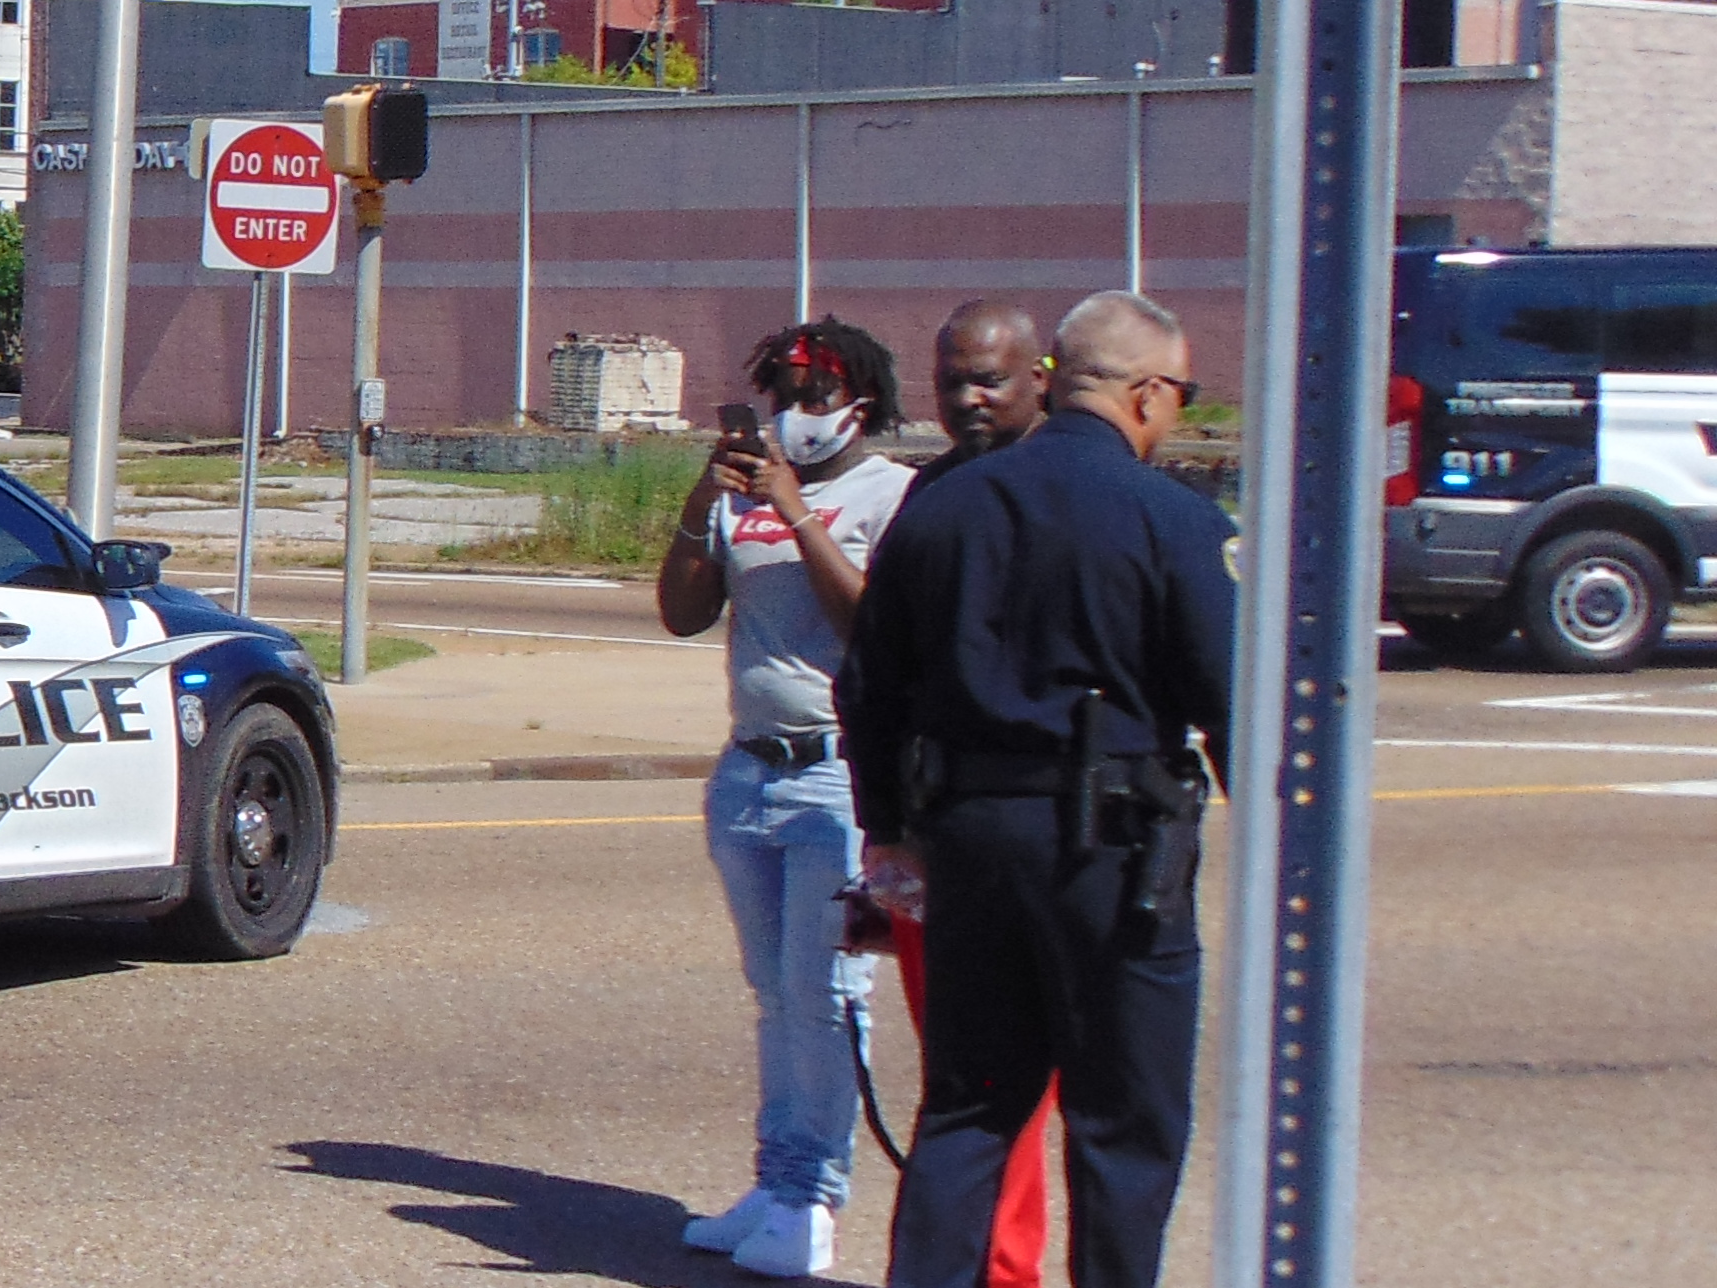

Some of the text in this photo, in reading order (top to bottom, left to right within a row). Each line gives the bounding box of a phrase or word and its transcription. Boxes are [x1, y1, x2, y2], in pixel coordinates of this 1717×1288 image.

[229, 151, 321, 178] DO NOT
[234, 216, 307, 242] ENTER
[1441, 450, 1514, 478] 911
